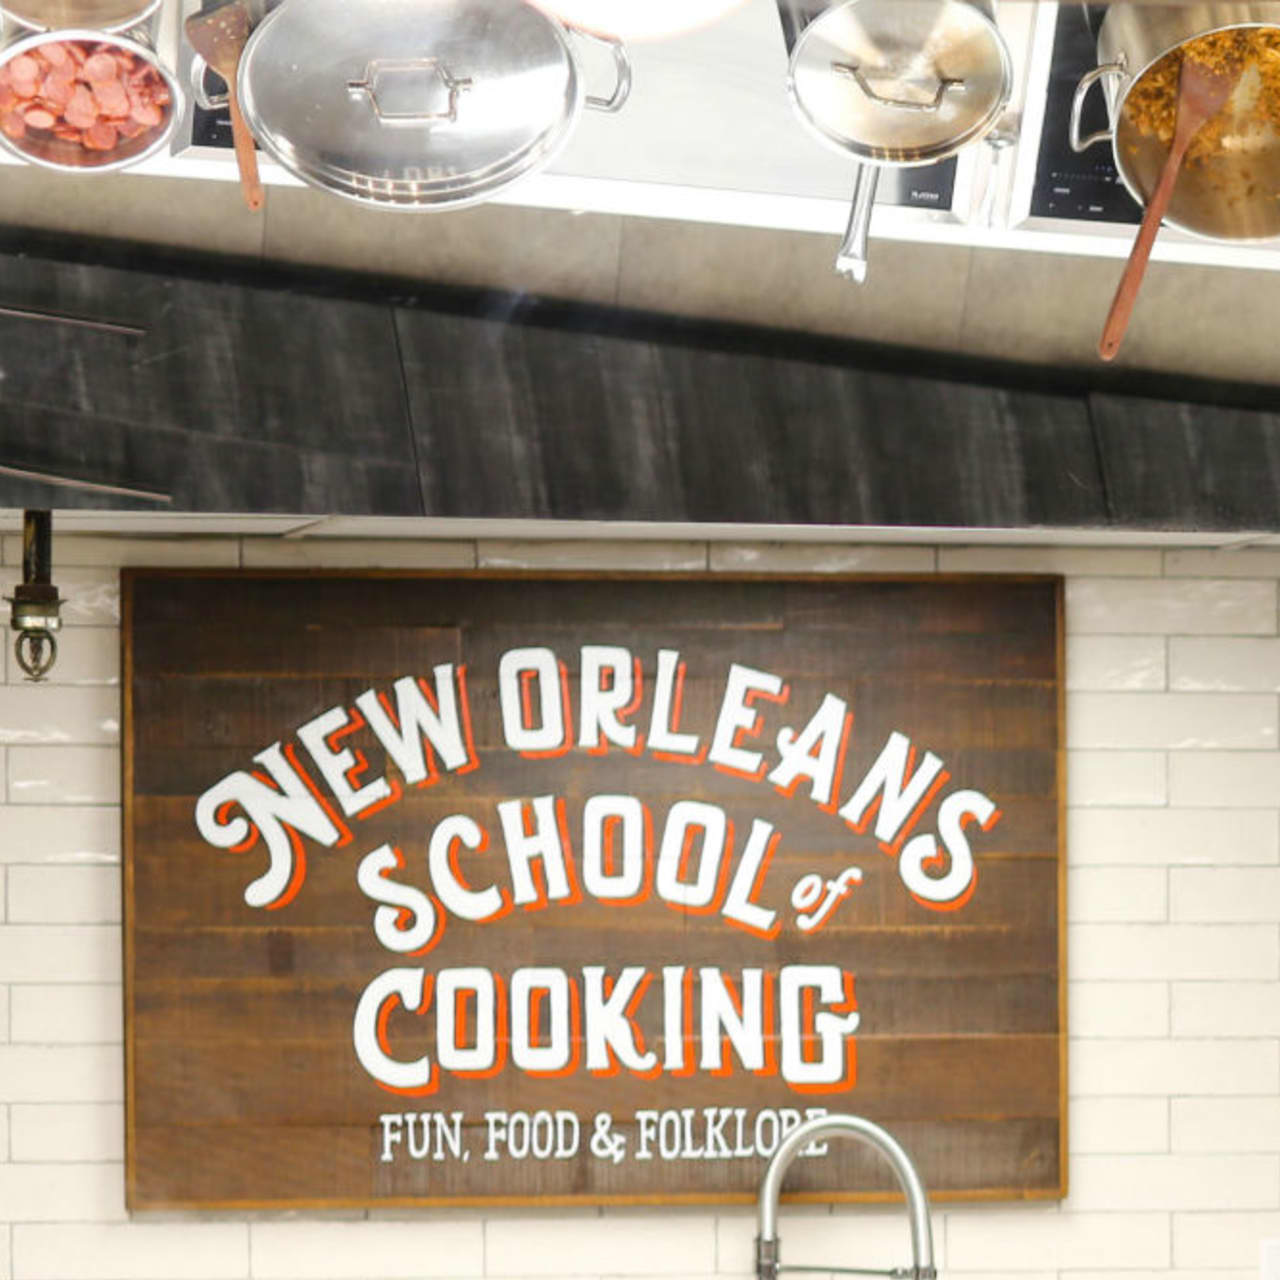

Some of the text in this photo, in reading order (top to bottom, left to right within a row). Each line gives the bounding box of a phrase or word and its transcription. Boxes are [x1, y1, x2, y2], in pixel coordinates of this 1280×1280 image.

[195, 644, 1000, 910] NEW ORLEANS
[357, 793, 862, 955] SCHOOL of
[353, 965, 859, 1096] COOKING
[379, 1112, 470, 1164] FUN,
[484, 1109, 580, 1160] FOOD
[589, 1110, 626, 1164] &
